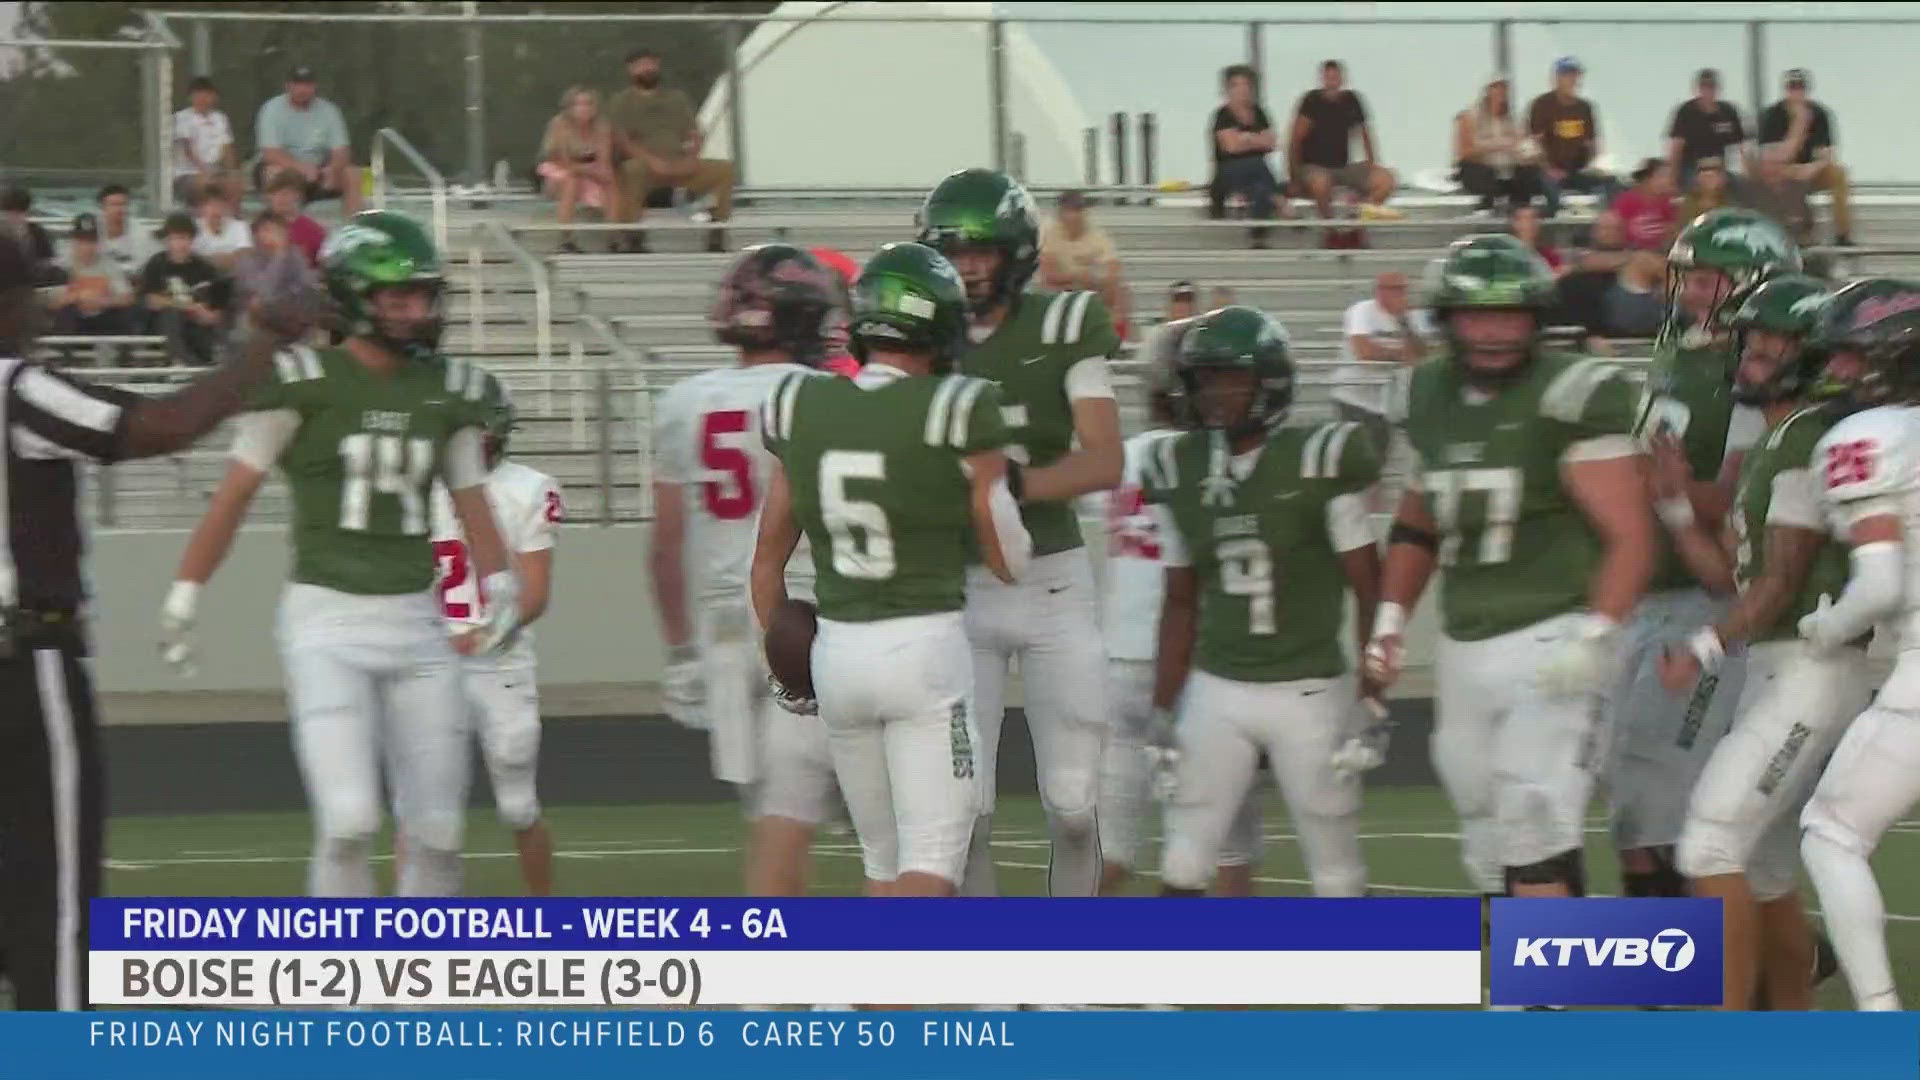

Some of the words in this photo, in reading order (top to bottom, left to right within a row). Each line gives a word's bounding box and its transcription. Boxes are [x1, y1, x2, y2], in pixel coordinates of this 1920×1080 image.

[337, 434, 435, 535] 14
[699, 411, 756, 516] 5
[818, 450, 896, 579] 6
[1215, 538, 1279, 635] 9
